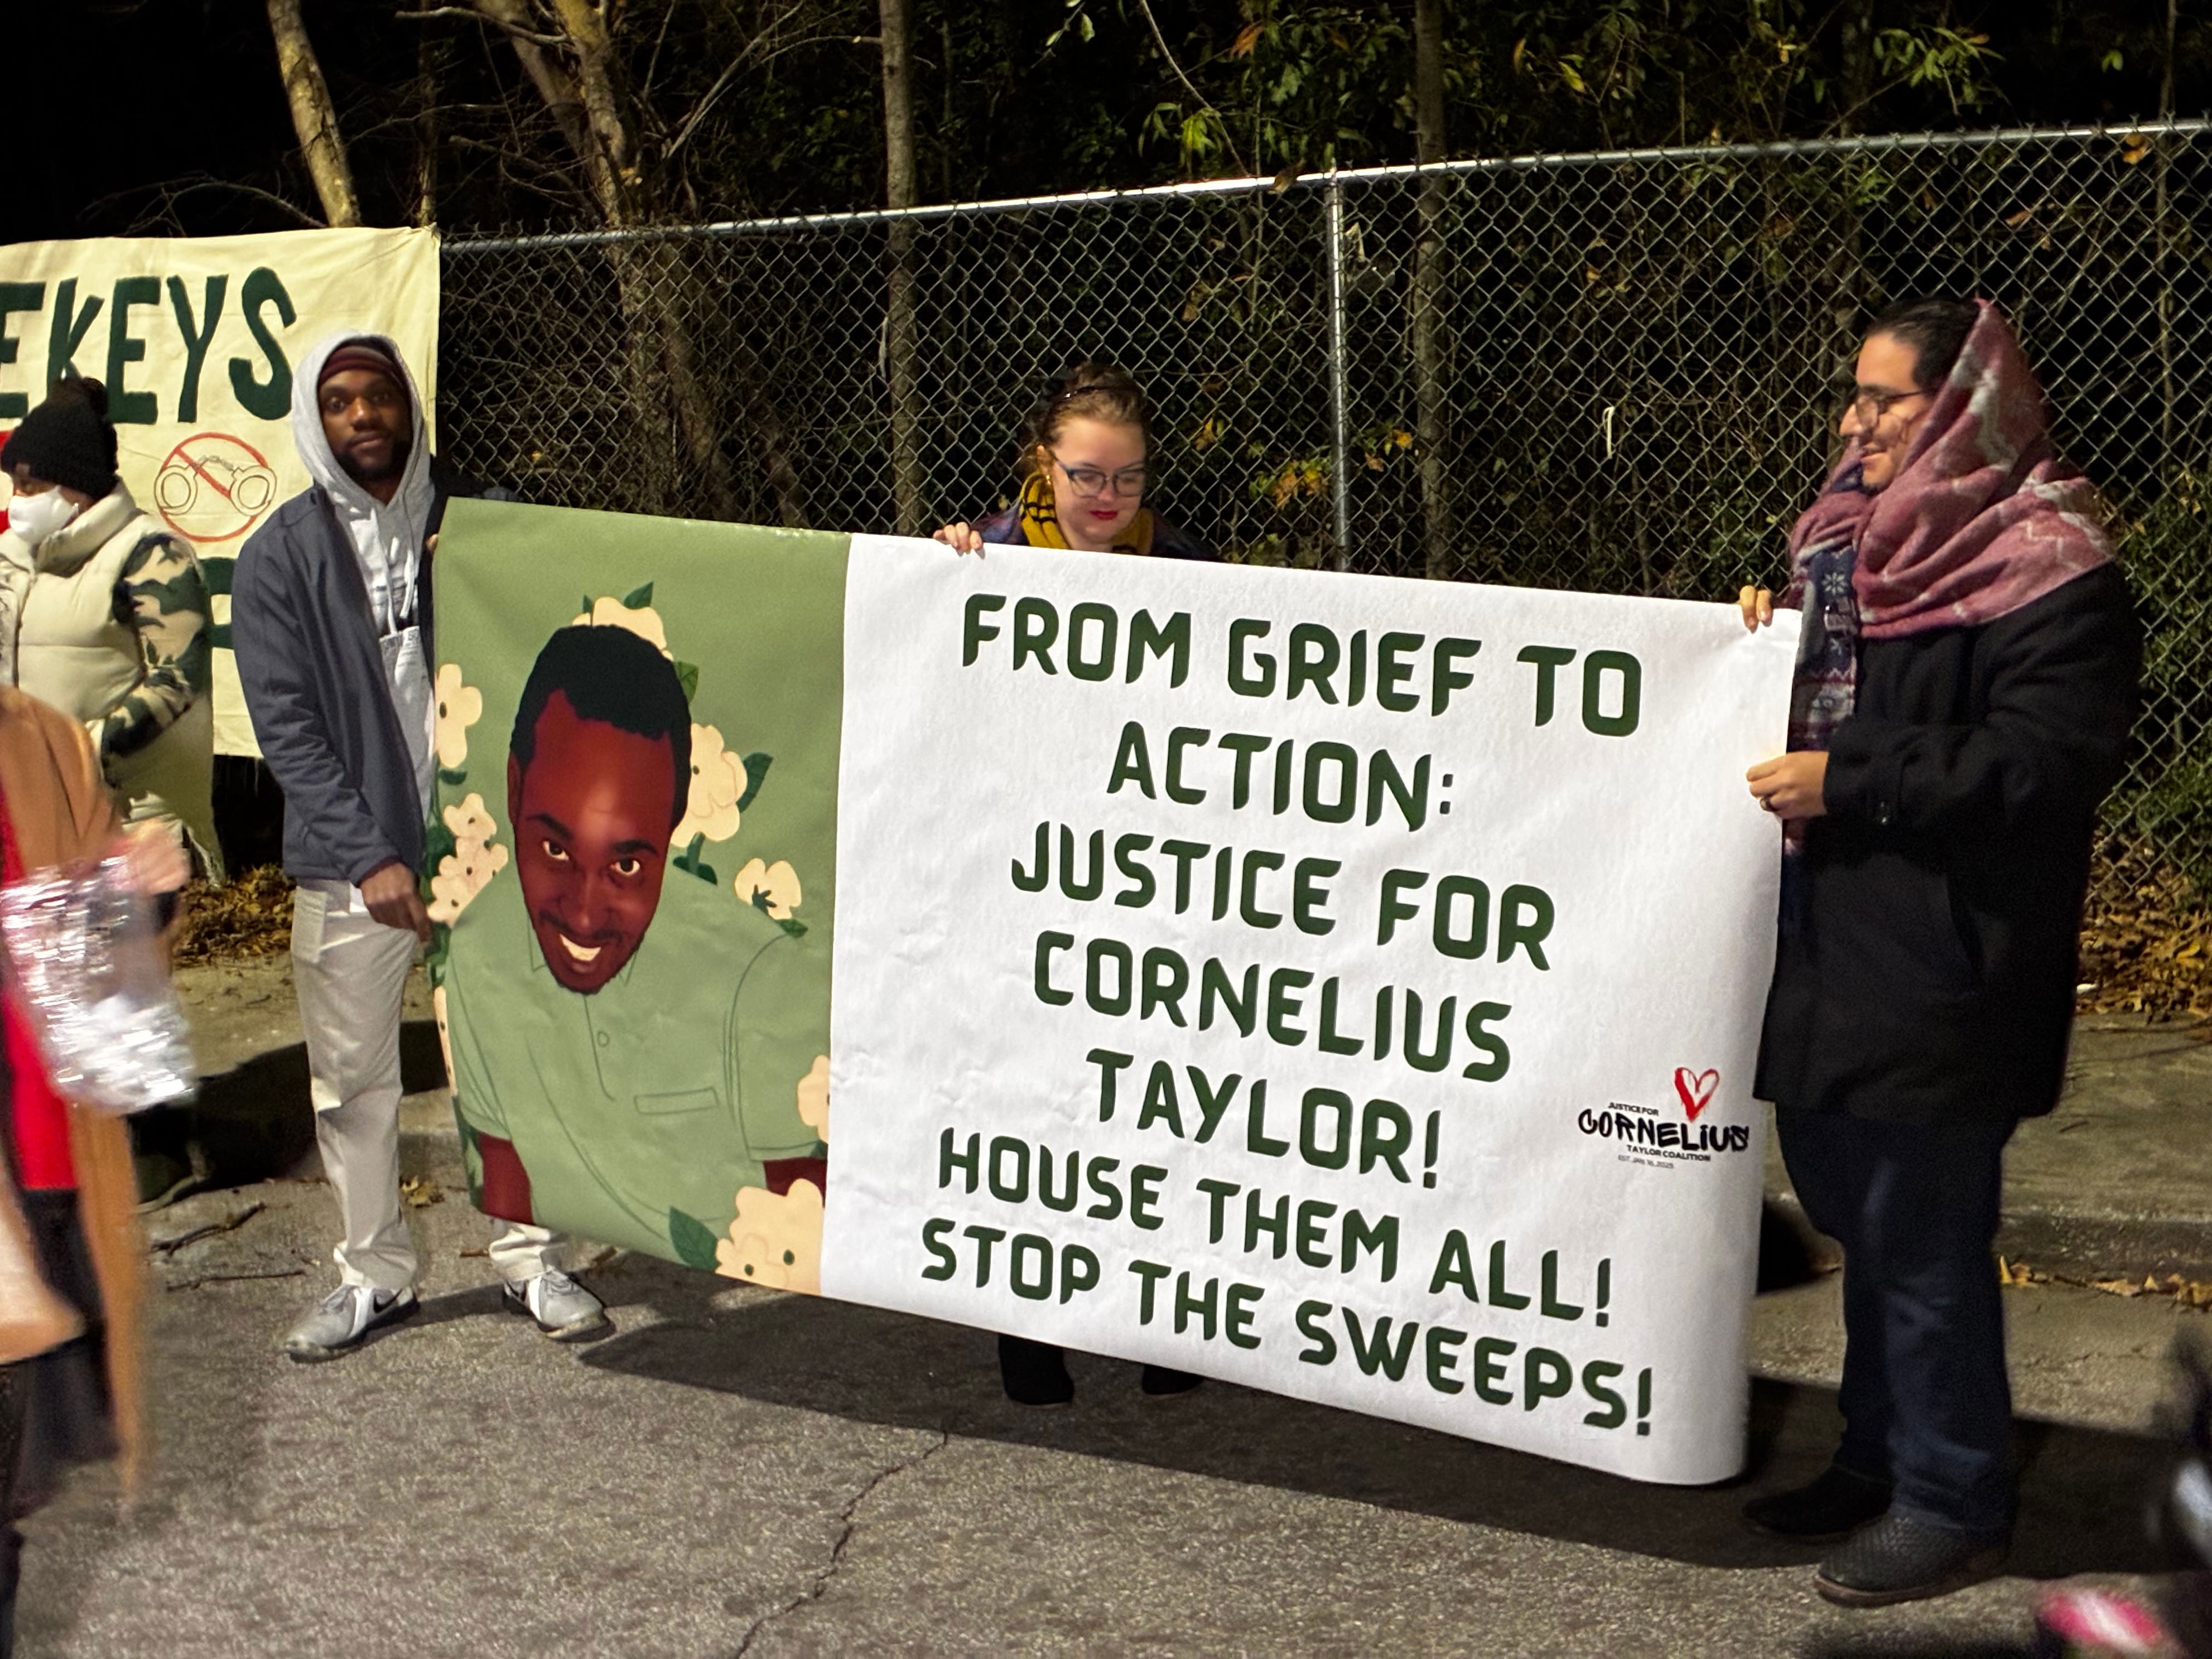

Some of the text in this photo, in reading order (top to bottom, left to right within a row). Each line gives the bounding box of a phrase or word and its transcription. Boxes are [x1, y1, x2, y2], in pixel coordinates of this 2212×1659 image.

[963, 594, 1641, 736] FROM GRIEF TO
[1107, 722, 1453, 832] ACTION:
[1012, 822, 1554, 970] JUSTICE FOR
[1035, 931, 1511, 1082] CORNELIUS
[1087, 1049, 1439, 1188] TAYLOR!
[1608, 1102, 1659, 1116] JUSTICE FOR
[1626, 1144, 1711, 1161] TAYLOR COALITION
[939, 1128, 1610, 1327] HOUSE THEM ALL!
[922, 1218, 1651, 1436] STOP THE SWEEPS!
